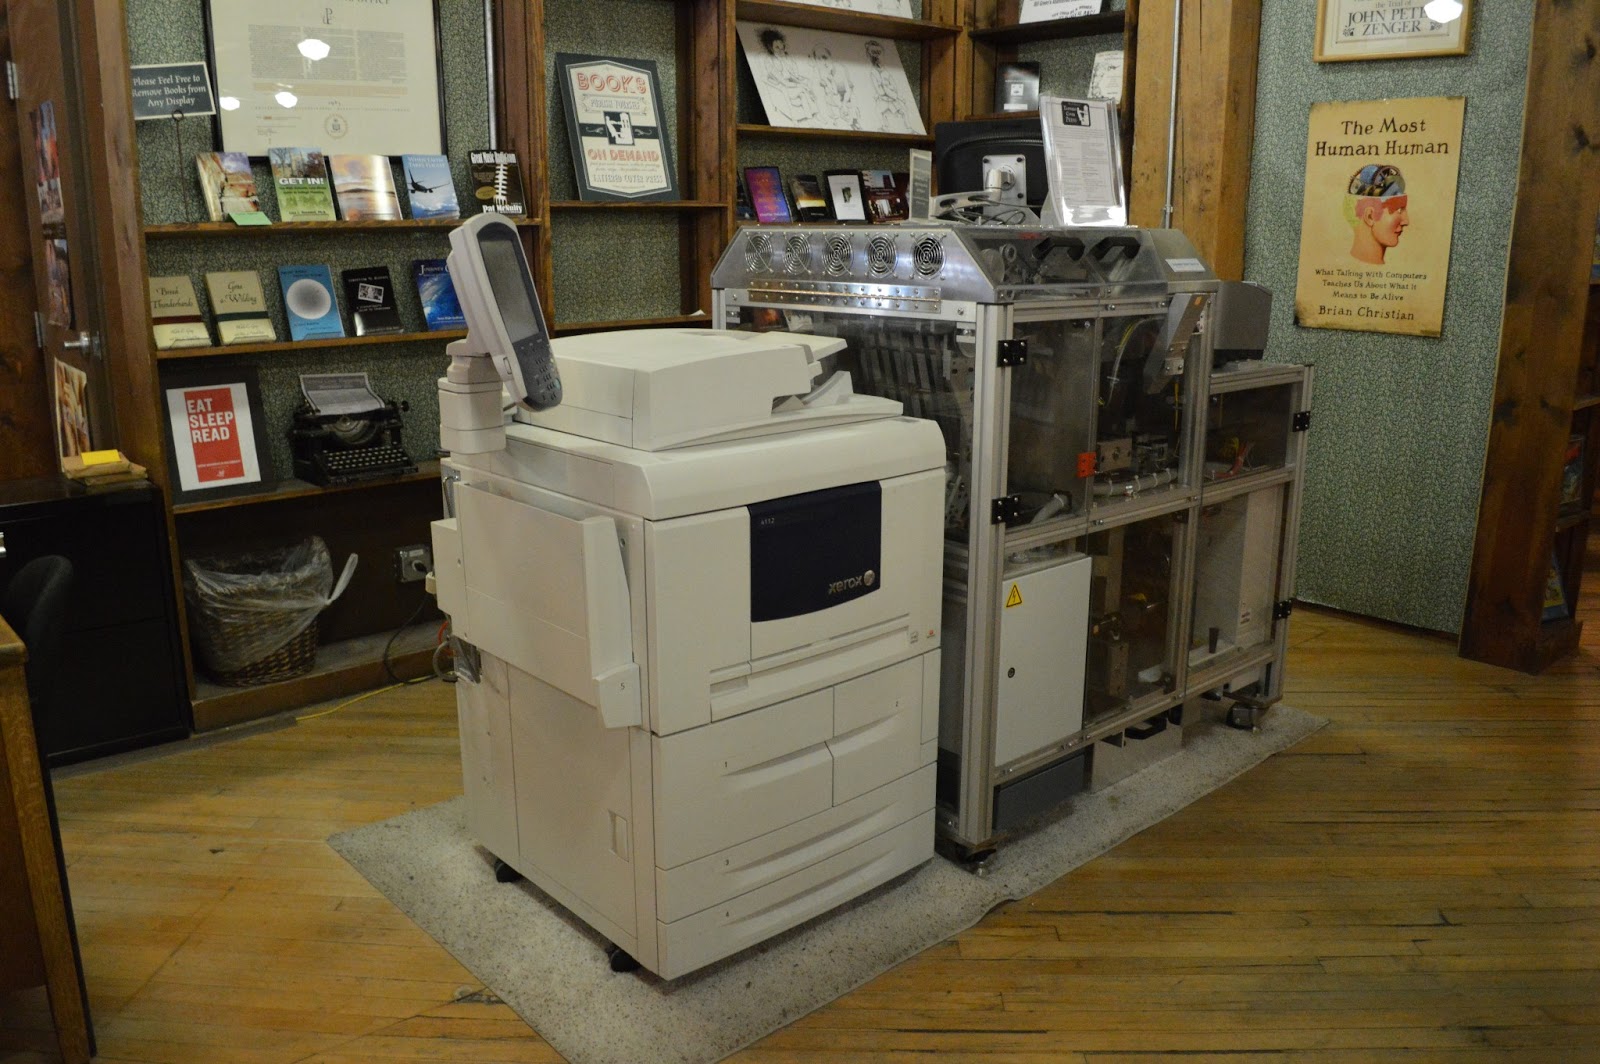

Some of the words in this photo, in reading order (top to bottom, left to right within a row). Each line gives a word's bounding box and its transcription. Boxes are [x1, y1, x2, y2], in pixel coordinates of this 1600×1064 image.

[1345, 10, 1386, 27] JOHN
[1392, 7, 1428, 20] PETE
[1362, 20, 1422, 36] ZENGER
[133, 77, 156, 86] Please
[158, 75, 173, 85] Feel
[175, 75, 191, 84] Free
[577, 72, 647, 94] BOOKS
[164, 85, 187, 95] Books
[187, 84, 207, 95] from
[147, 99, 164, 107] Any
[166, 96, 196, 107] Display
[1341, 120, 1374, 135] The
[1379, 117, 1426, 133] Most
[588, 148, 607, 161] ON
[609, 148, 660, 162] DEMAND
[1315, 141, 1380, 156] Human
[1384, 140, 1449, 155] Human
[279, 177, 302, 185] GET
[307, 177, 324, 185] IN!
[482, 204, 496, 214] Pat
[496, 204, 522, 214] McNulty
[1336, 269, 1363, 279] Talking
[1385, 271, 1427, 280] Computers
[1322, 280, 1352, 288] Teaches
[1354, 280, 1364, 288] Us
[1365, 281, 1387, 289] About
[1389, 282, 1409, 290] What
[1332, 291, 1358, 299] Means
[1370, 292, 1379, 300] Be
[1381, 293, 1404, 301] Alive
[1318, 305, 1353, 316] Brian
[1357, 306, 1414, 320] Christian
[186, 397, 213, 414] EAT
[189, 411, 234, 427] SLEEP
[192, 427, 230, 444] READ
[828, 574, 863, 595] xerox
[620, 682, 626, 690] 5
